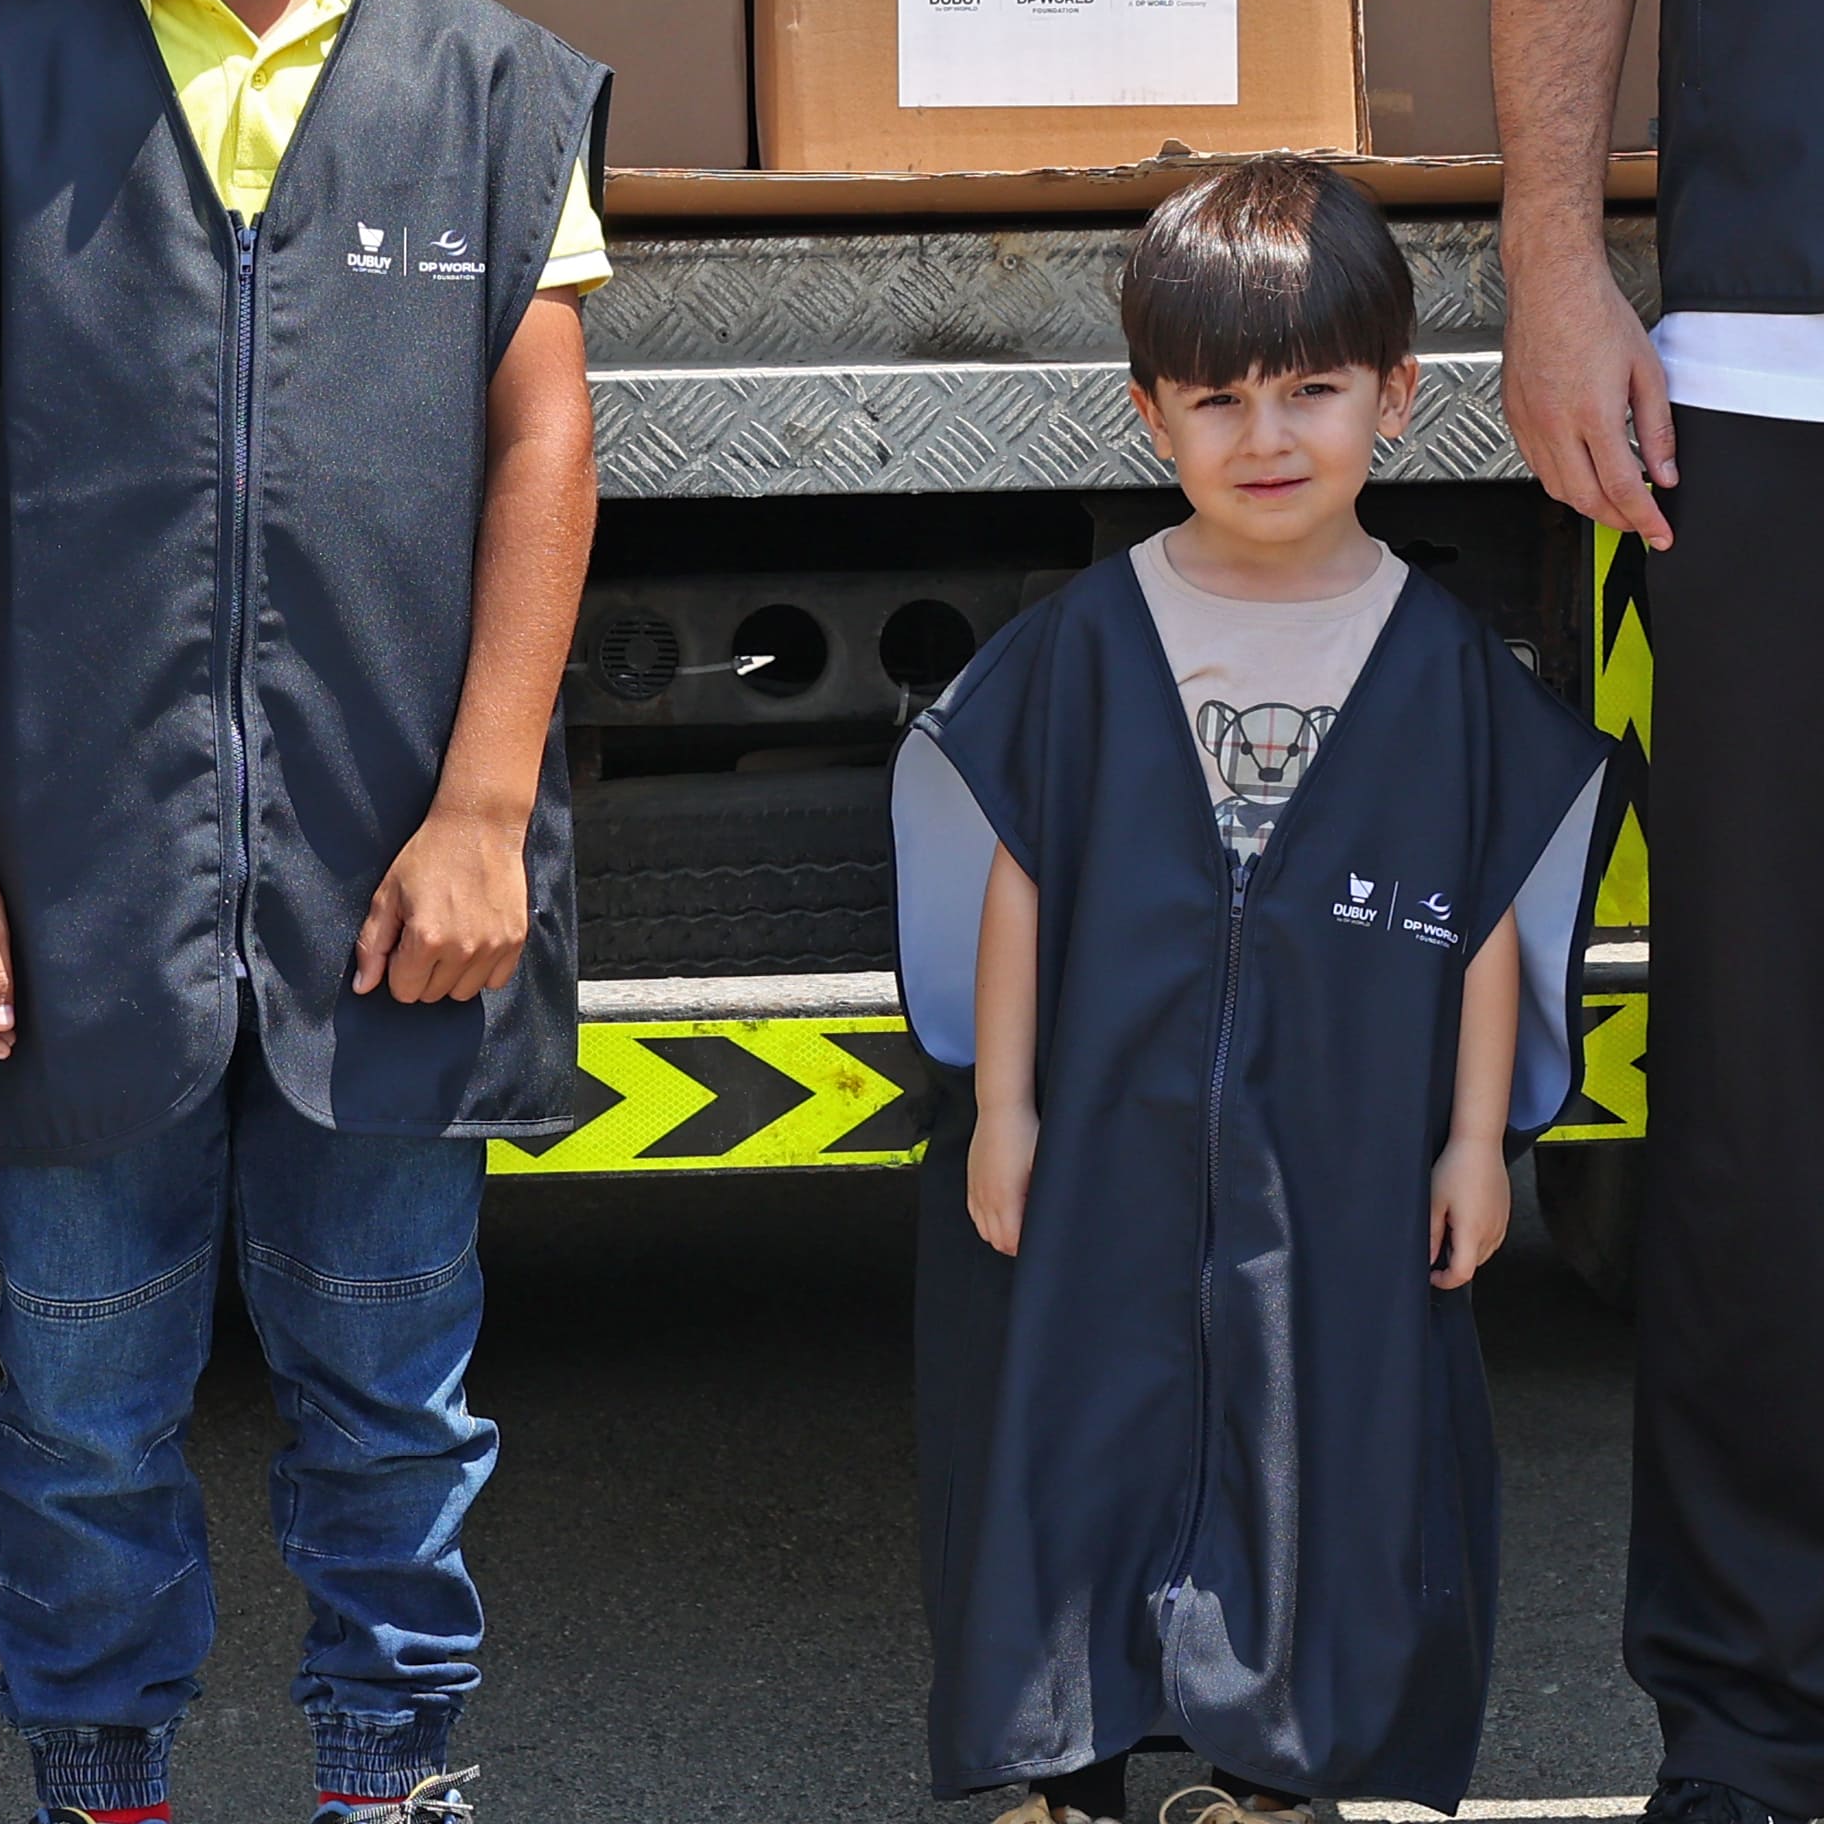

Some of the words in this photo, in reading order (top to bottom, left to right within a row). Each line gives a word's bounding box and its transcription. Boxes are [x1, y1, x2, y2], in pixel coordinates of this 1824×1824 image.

[347, 253, 392, 269] DUBUY
[418, 262, 438, 272] DP
[439, 262, 485, 273] WORLD
[1333, 903, 1377, 922] DUBUY
[1403, 919, 1422, 930] DP
[1423, 923, 1459, 944] WORLD
